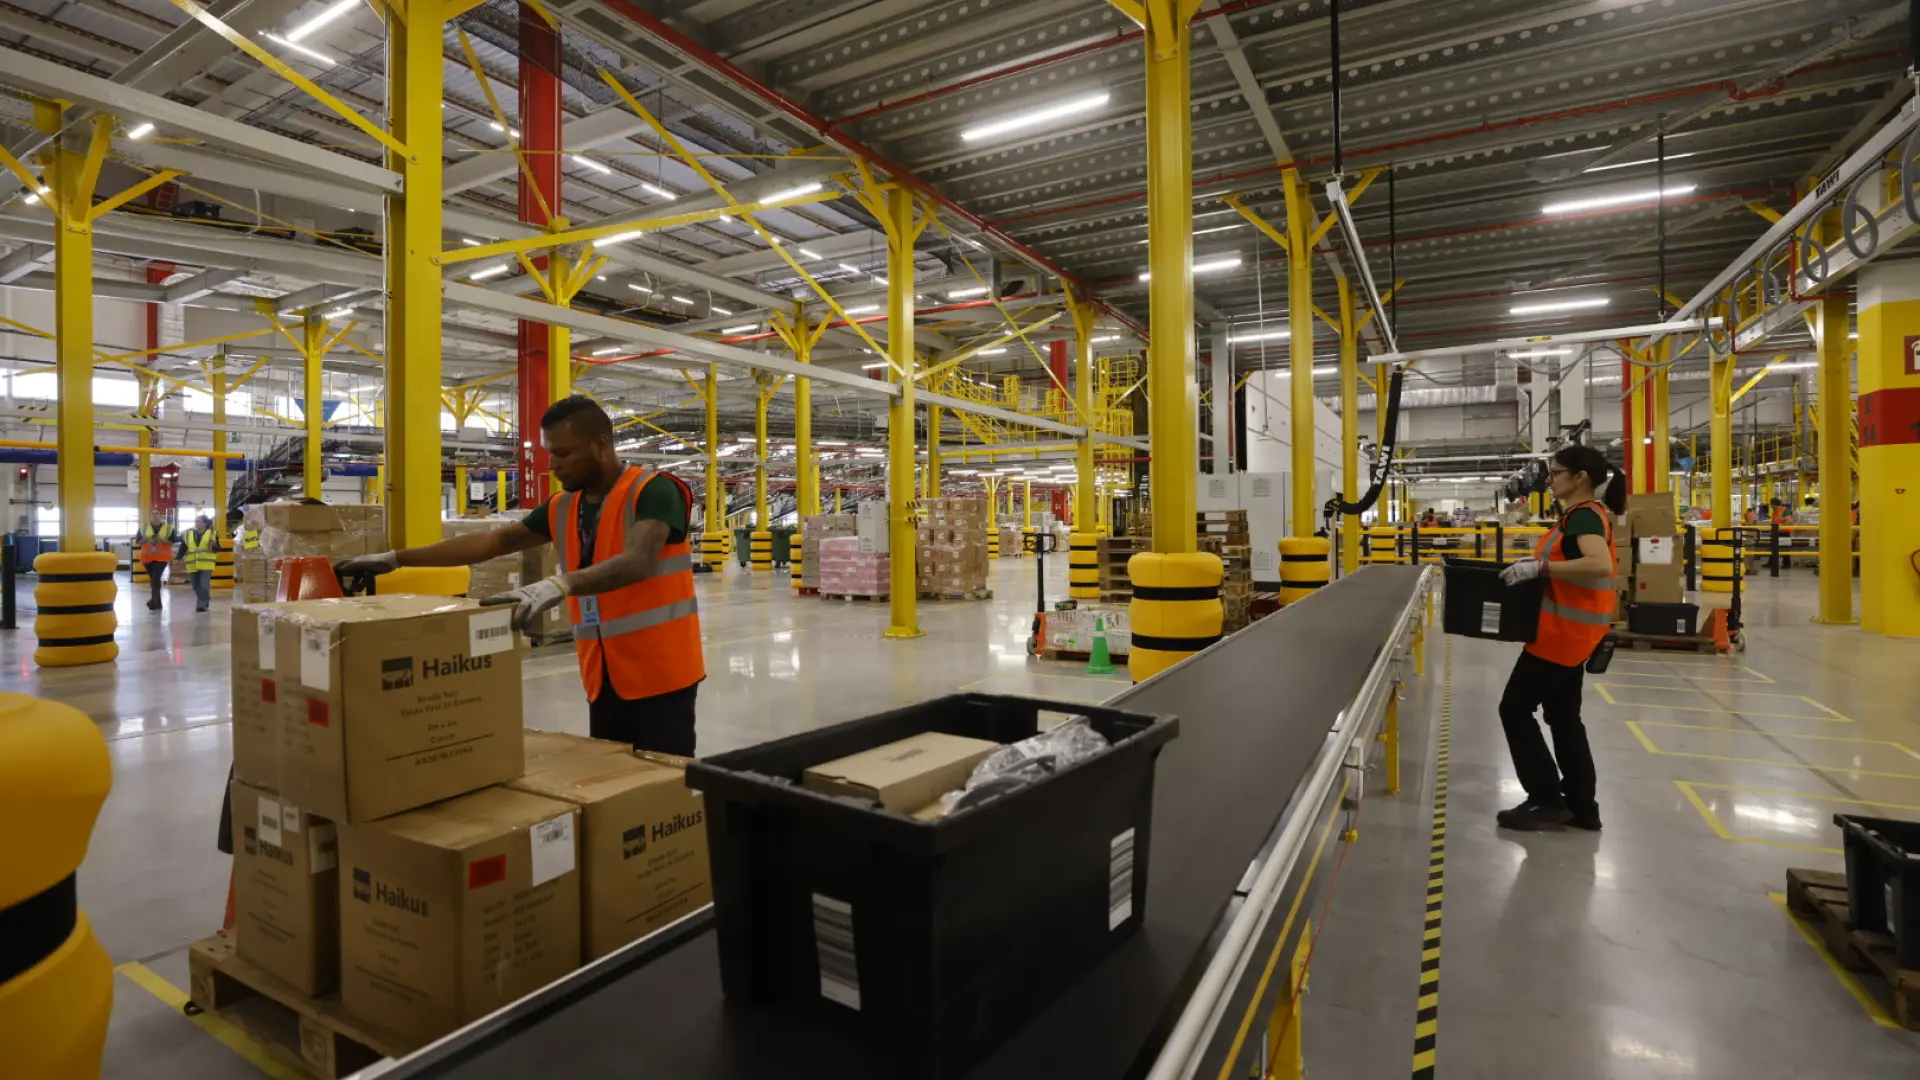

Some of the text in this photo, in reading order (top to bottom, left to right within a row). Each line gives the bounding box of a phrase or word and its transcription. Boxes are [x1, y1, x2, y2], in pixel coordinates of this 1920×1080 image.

[1815, 168, 1840, 199] TAWI
[1372, 445, 1390, 485] TAWI
[423, 653, 492, 679] Haikus
[652, 810, 703, 842] Haikus
[376, 882, 429, 918] Haikus
